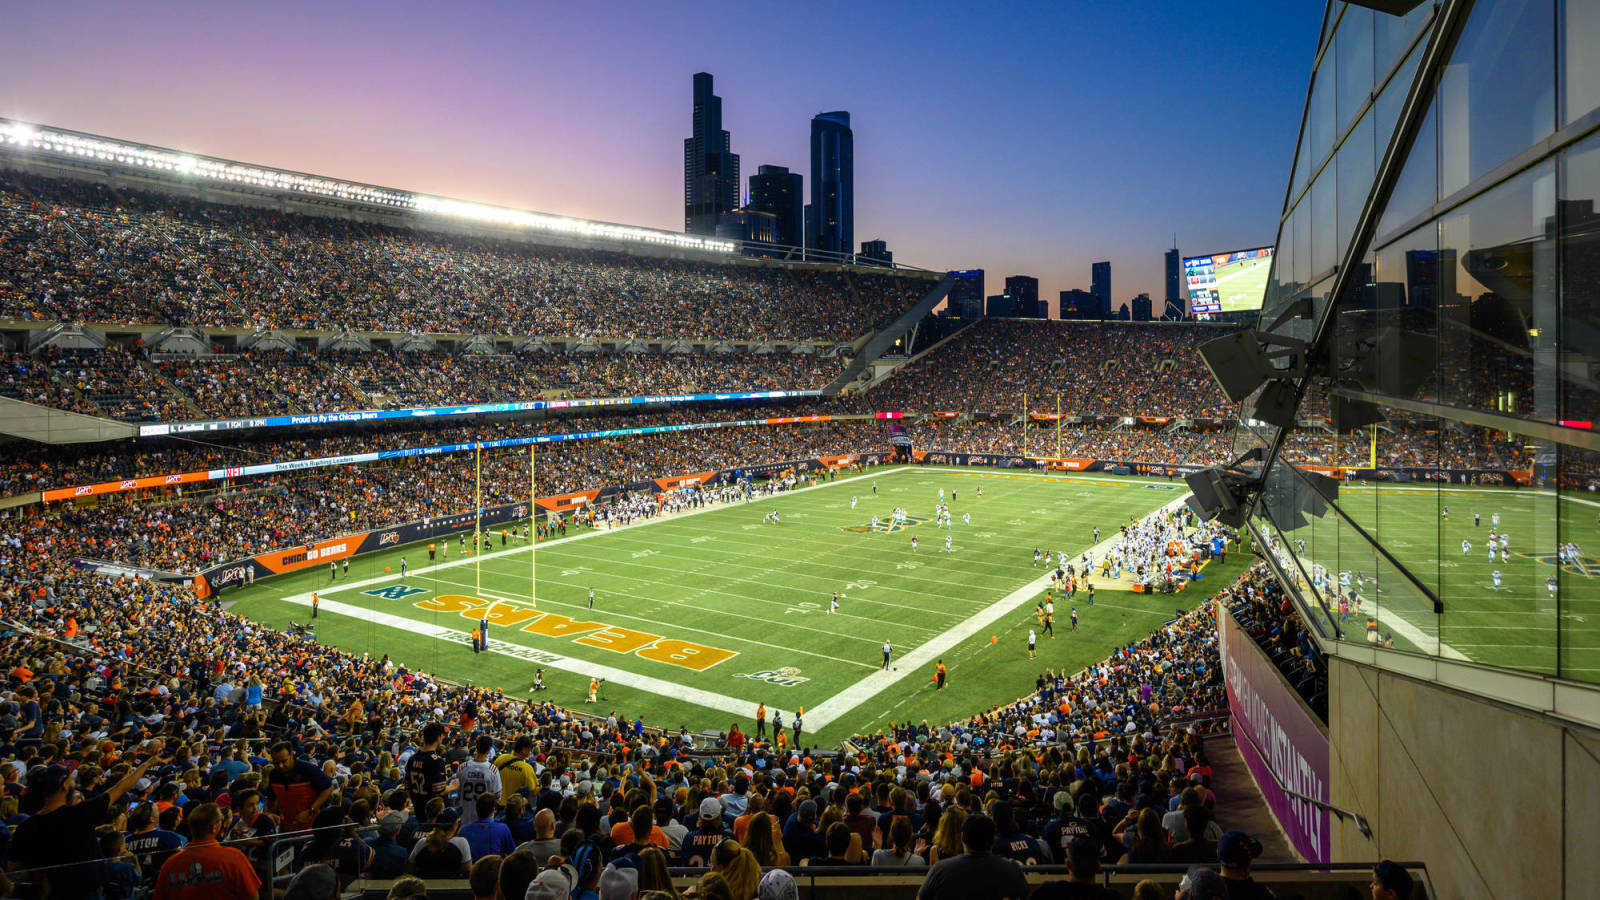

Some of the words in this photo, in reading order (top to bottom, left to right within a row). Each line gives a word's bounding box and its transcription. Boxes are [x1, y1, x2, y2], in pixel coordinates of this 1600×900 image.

[225, 467, 243, 478] NFL
[282, 550, 318, 565] CHICAGO
[320, 544, 346, 557] BEARS
[413, 594, 741, 672] BEARS
[410, 771, 428, 795] 52
[1271, 713, 1322, 863] INSTANTLY
[692, 834, 723, 846] PAYTON
